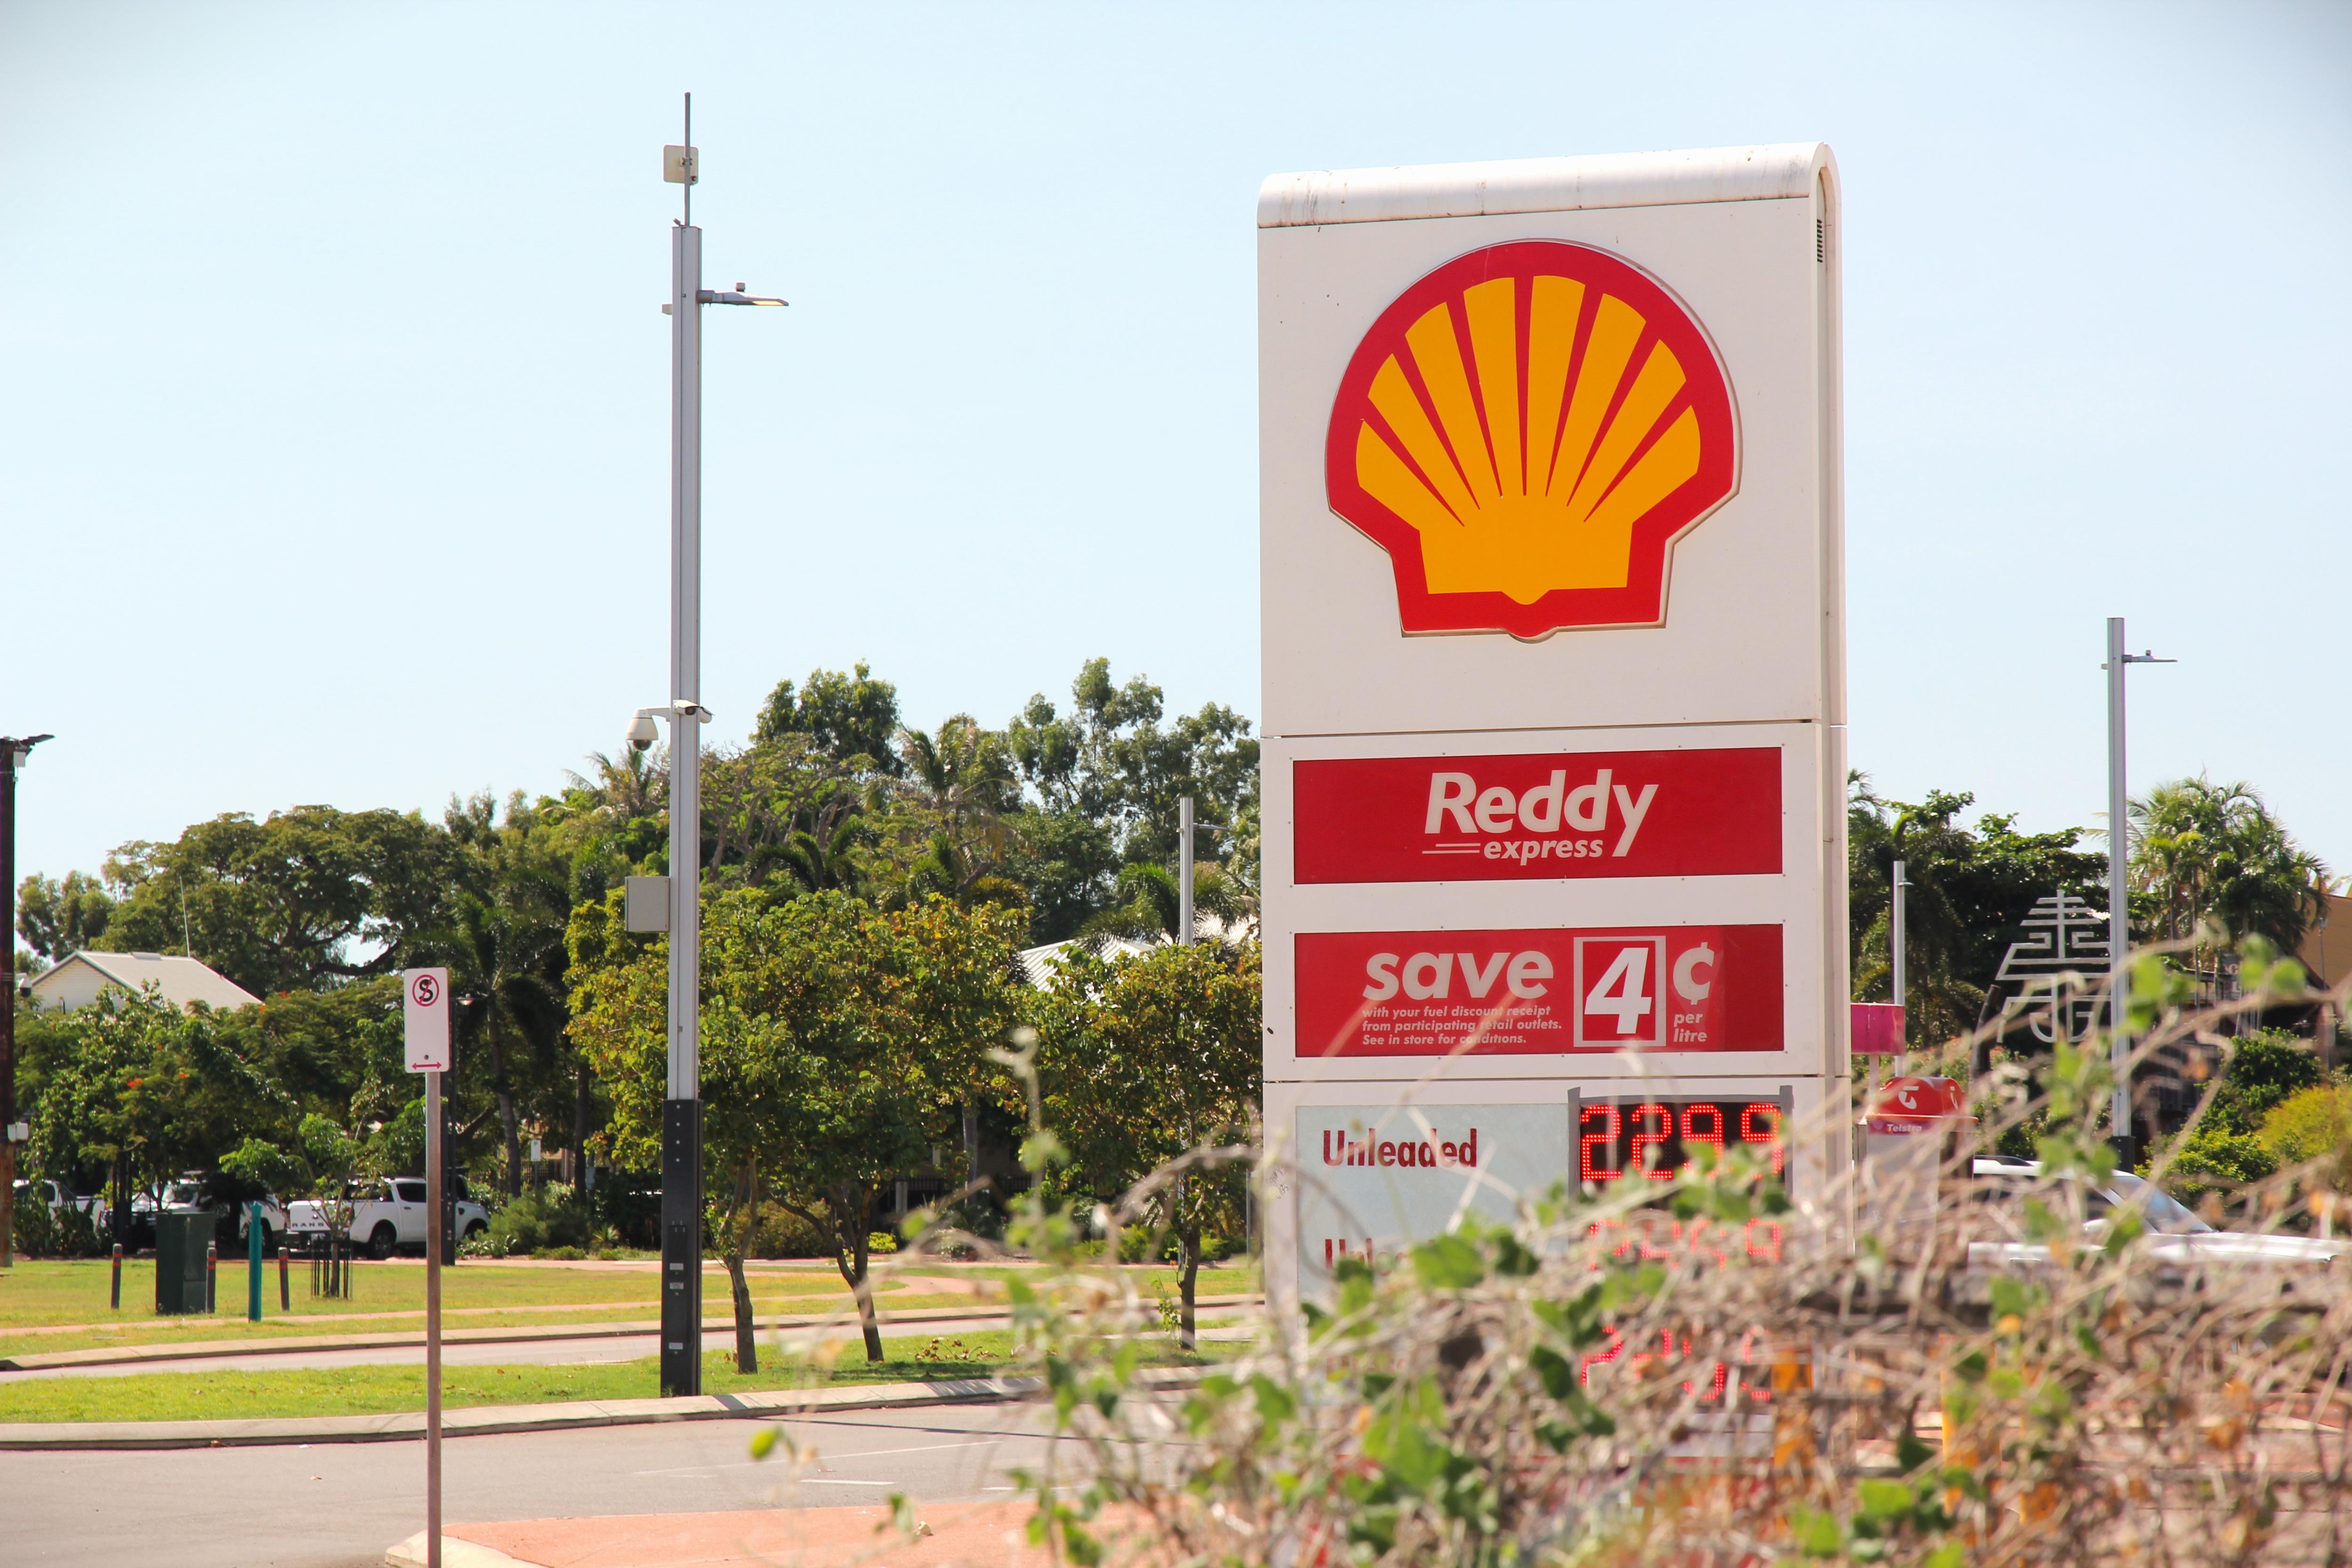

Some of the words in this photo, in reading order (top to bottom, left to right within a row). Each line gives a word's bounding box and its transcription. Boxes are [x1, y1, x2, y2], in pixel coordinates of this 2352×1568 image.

[1425, 769, 1659, 857] Reddy
[1484, 839, 1603, 866] express
[1362, 950, 1554, 1001] save
[1584, 947, 1652, 1034] 4
[1362, 1007, 1389, 1017] with
[1392, 1009, 1420, 1020] your
[1423, 1006, 1447, 1017] fuel
[1451, 1006, 1504, 1016] discount
[1507, 1005, 1551, 1018] receipt
[1673, 1013, 1703, 1027] per
[1362, 1020, 1391, 1031] from
[1395, 1019, 1476, 1033] participating
[1480, 1019, 1513, 1030] retail
[1517, 1018, 1562, 1029] outlets.
[1362, 1035, 1385, 1045] See
[1388, 1035, 1400, 1044] in
[1404, 1035, 1434, 1044] store
[1438, 1034, 1456, 1044] for
[1460, 1033, 1526, 1044] conditions.
[1673, 1028, 1707, 1042] litre
[1323, 1128, 1477, 1167] Unleaded
